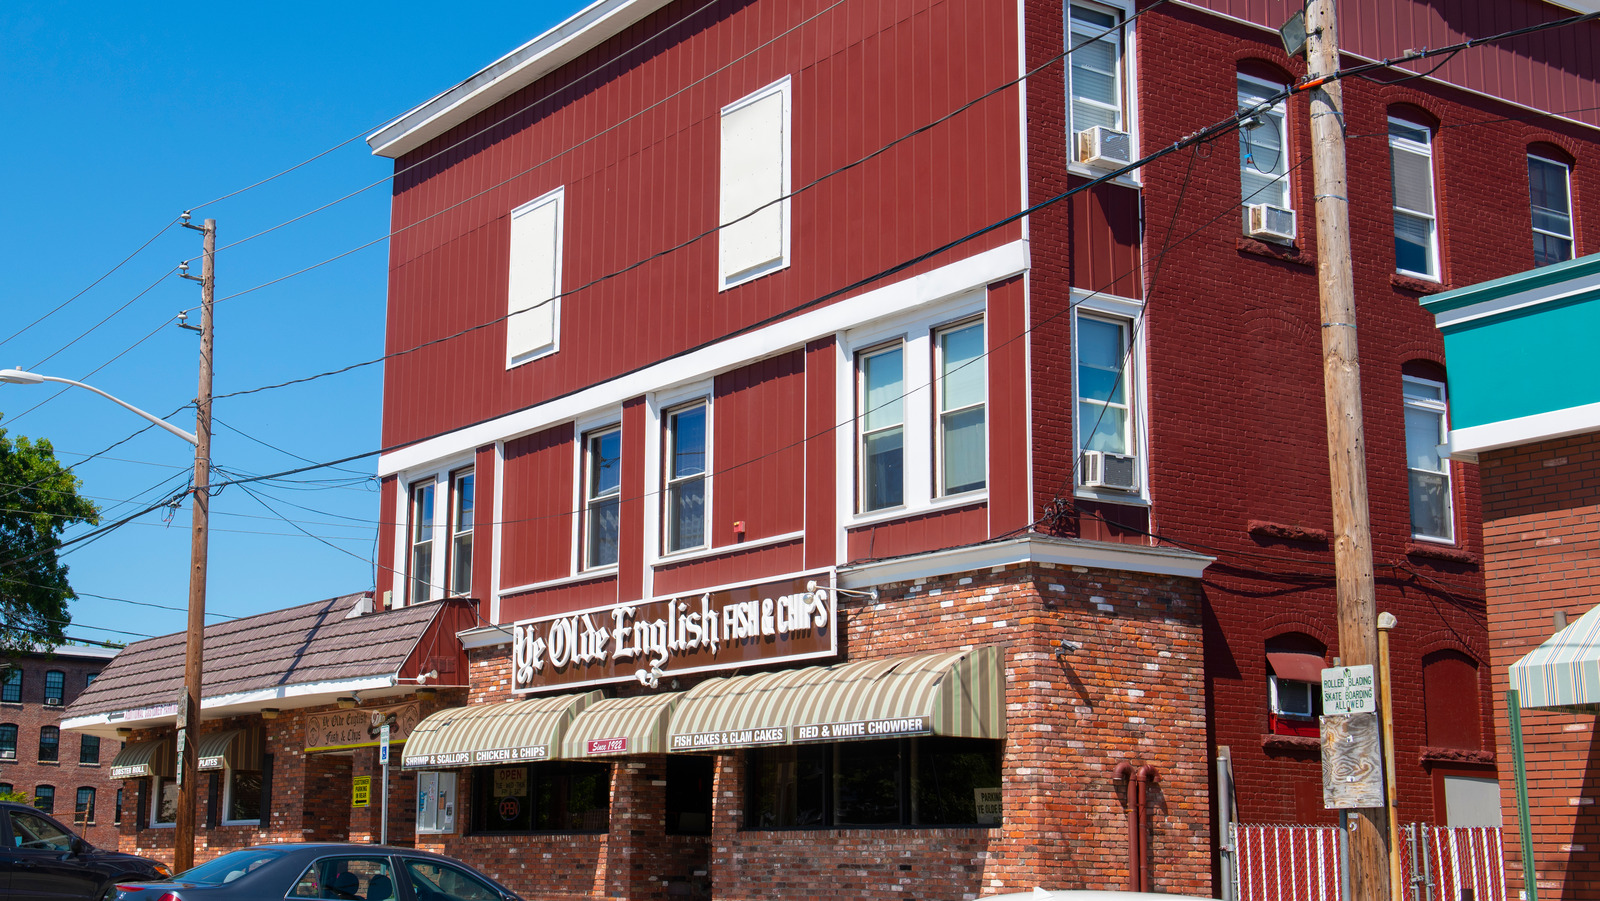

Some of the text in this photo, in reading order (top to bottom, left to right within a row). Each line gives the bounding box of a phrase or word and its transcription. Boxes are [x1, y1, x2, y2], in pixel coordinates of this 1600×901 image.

[516, 589, 828, 684] Ye Olde English FISH & CHIPS
[1343, 669, 1351, 678] NO
[1324, 676, 1371, 688] ROLLER BLADING
[1325, 689, 1372, 702] SKATE BOARDING
[1335, 700, 1364, 710] ALLOWED
[799, 718, 923, 739] RED & WHITE CHOWDER
[674, 729, 783, 747] FISH CAKES & CLAM CAKES
[592, 740, 622, 751] Since 1922
[405, 753, 469, 766] SHRIMP & SCALLOPS
[476, 747, 545, 761] CHICKEN & CHIPS
[199, 758, 218, 767] PLATES
[112, 766, 144, 776] LOBSTER ROLL
[500, 769, 522, 780] OPEN
